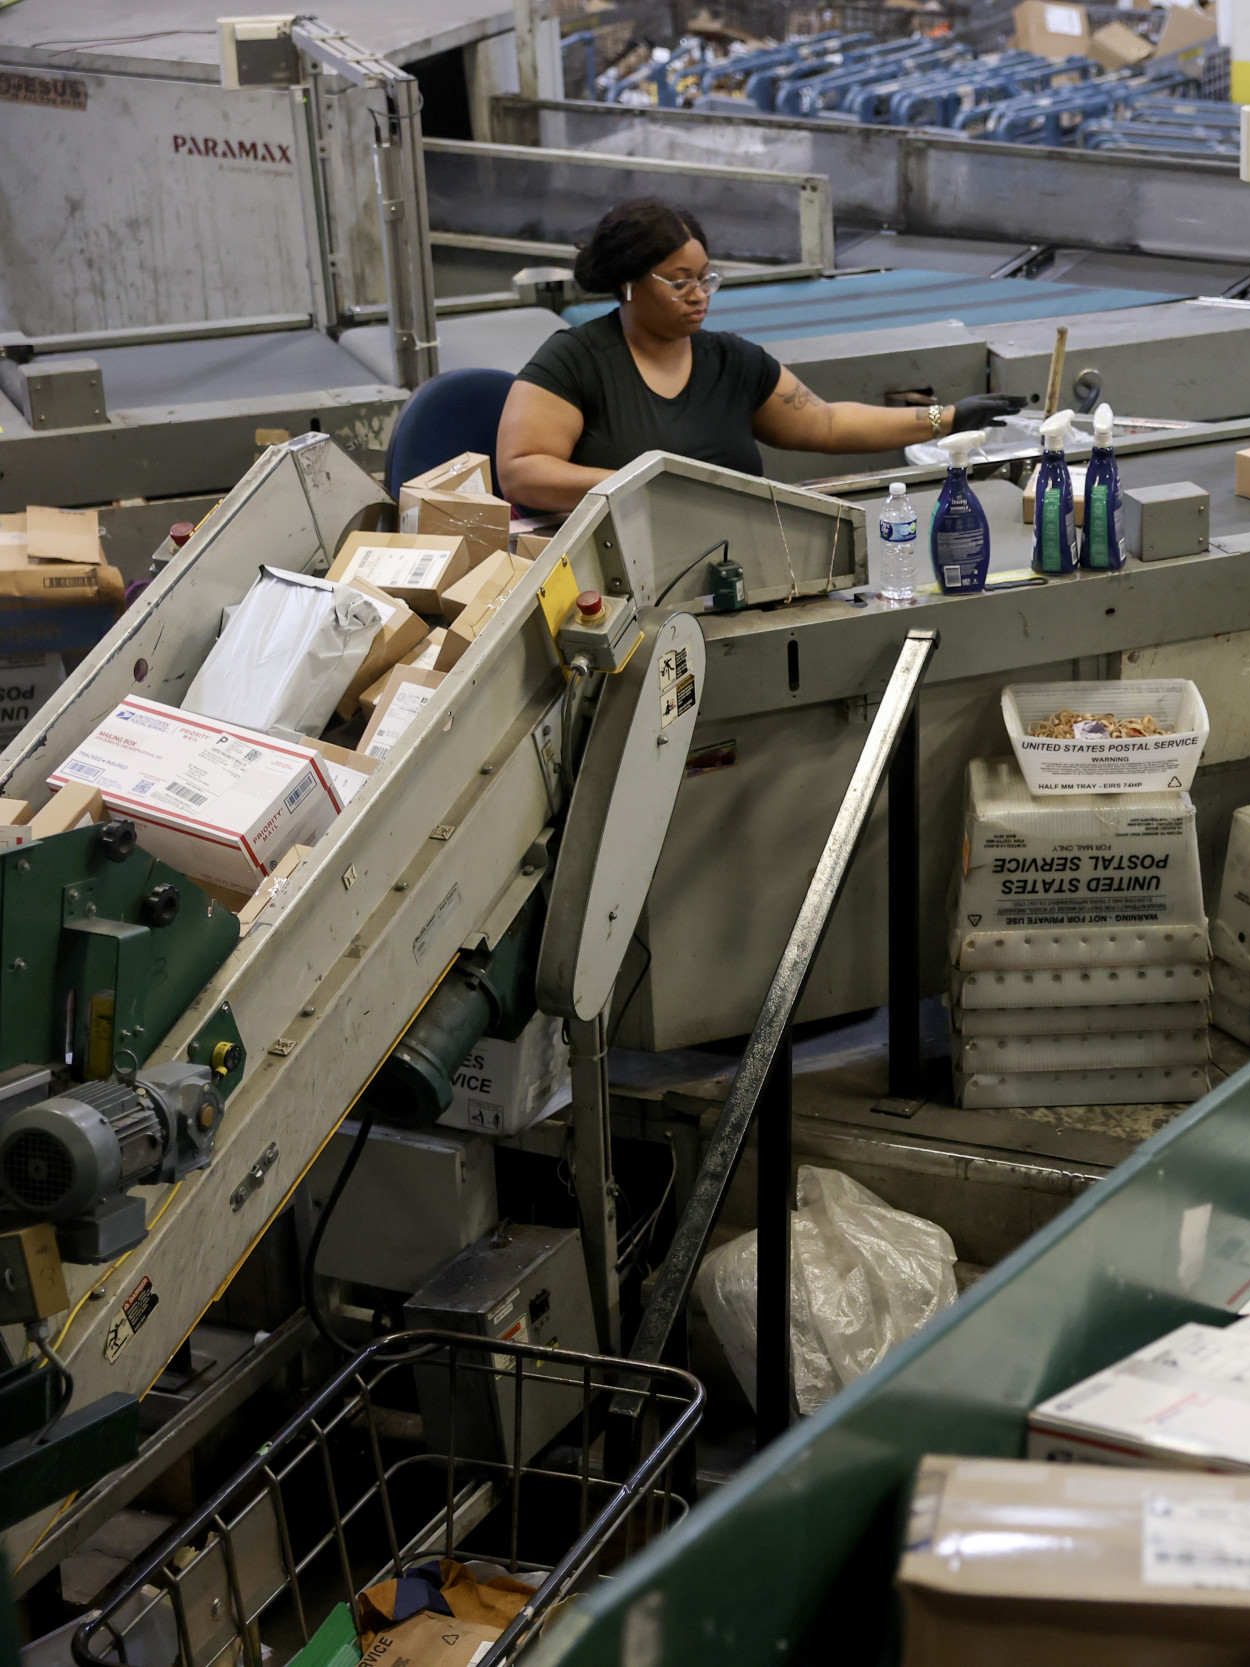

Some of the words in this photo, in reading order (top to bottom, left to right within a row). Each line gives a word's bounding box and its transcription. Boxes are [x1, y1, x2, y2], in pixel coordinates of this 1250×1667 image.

[173, 135, 292, 164] PARAMAX
[98, 730, 124, 743] MAILING
[123, 738, 137, 746] BOX
[216, 736, 229, 744] P
[1021, 741, 1061, 752] UNITED
[1064, 744, 1106, 753] STATES
[1108, 743, 1150, 752] POSTAL
[1153, 736, 1199, 750] SERVICE
[263, 825, 278, 842] MAIL
[1052, 844, 1076, 852] ONLY
[992, 856, 1082, 874] SERVICE
[1088, 854, 1170, 871] POSTAL
[1001, 878, 1081, 895] STATES
[1086, 876, 1161, 892] UNITED
[1006, 917, 1025, 925] USE
[1027, 915, 1064, 924] PRIVATE
[1067, 914, 1085, 923] FOR
[1090, 914, 1108, 922] NOT
[1115, 913, 1158, 922] WARNING
